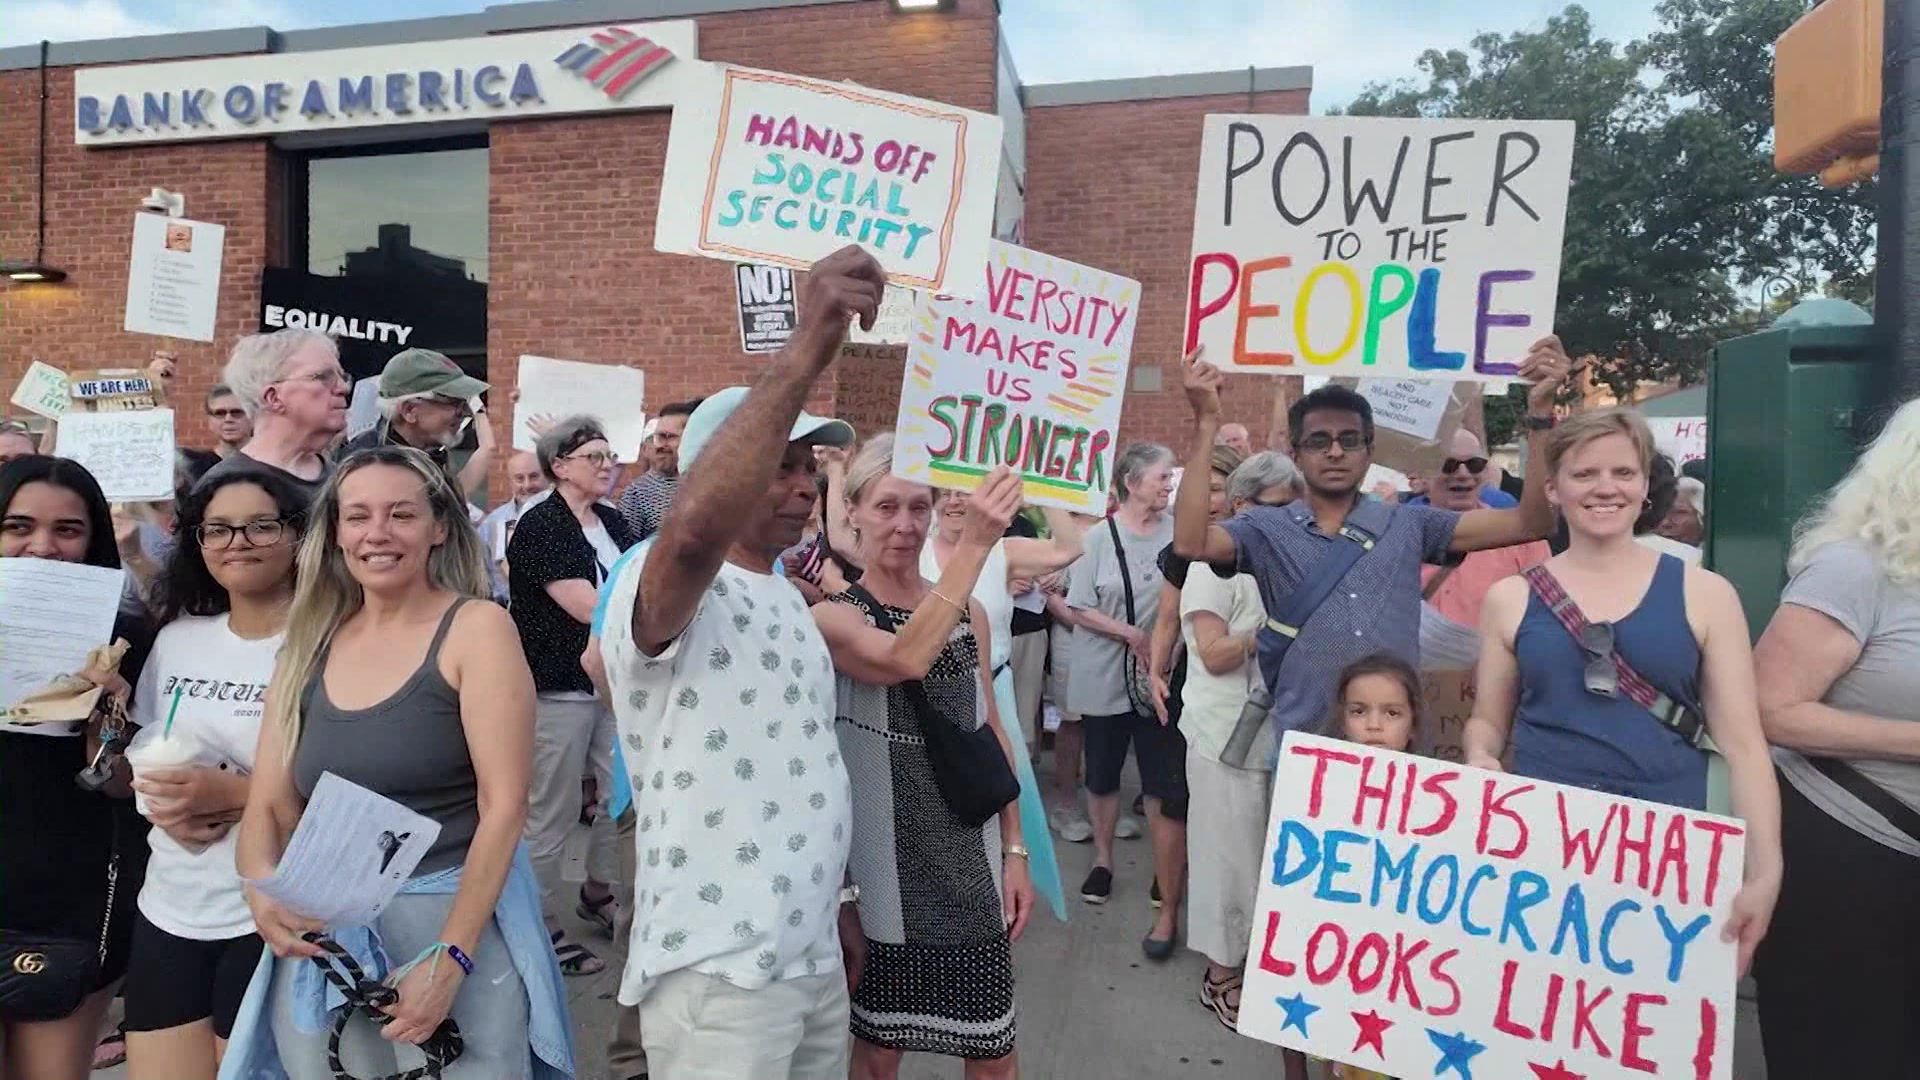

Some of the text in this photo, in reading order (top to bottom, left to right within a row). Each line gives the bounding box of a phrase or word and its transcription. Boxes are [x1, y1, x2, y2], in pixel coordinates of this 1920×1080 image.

[78, 62, 542, 132] BANK OF AMERICA
[744, 113, 937, 184] HANDS OFF
[752, 151, 910, 217] SOCIAL
[1224, 121, 1541, 227] POWER
[717, 189, 935, 260] SECURITY
[1316, 227, 1449, 262] TO THE
[739, 265, 792, 304] NO!
[934, 260, 1128, 347] VERSITY
[1182, 252, 1536, 376] PEOPLE
[264, 304, 414, 345] EQUALITY
[942, 316, 1078, 380] MAKES
[986, 368, 1032, 402] US
[925, 394, 1111, 493] STRONGER
[1290, 745, 1745, 907] THIS IS WHAT
[1272, 818, 1712, 984] DEMOCRACY
[1257, 910, 1461, 1017] LOOKS
